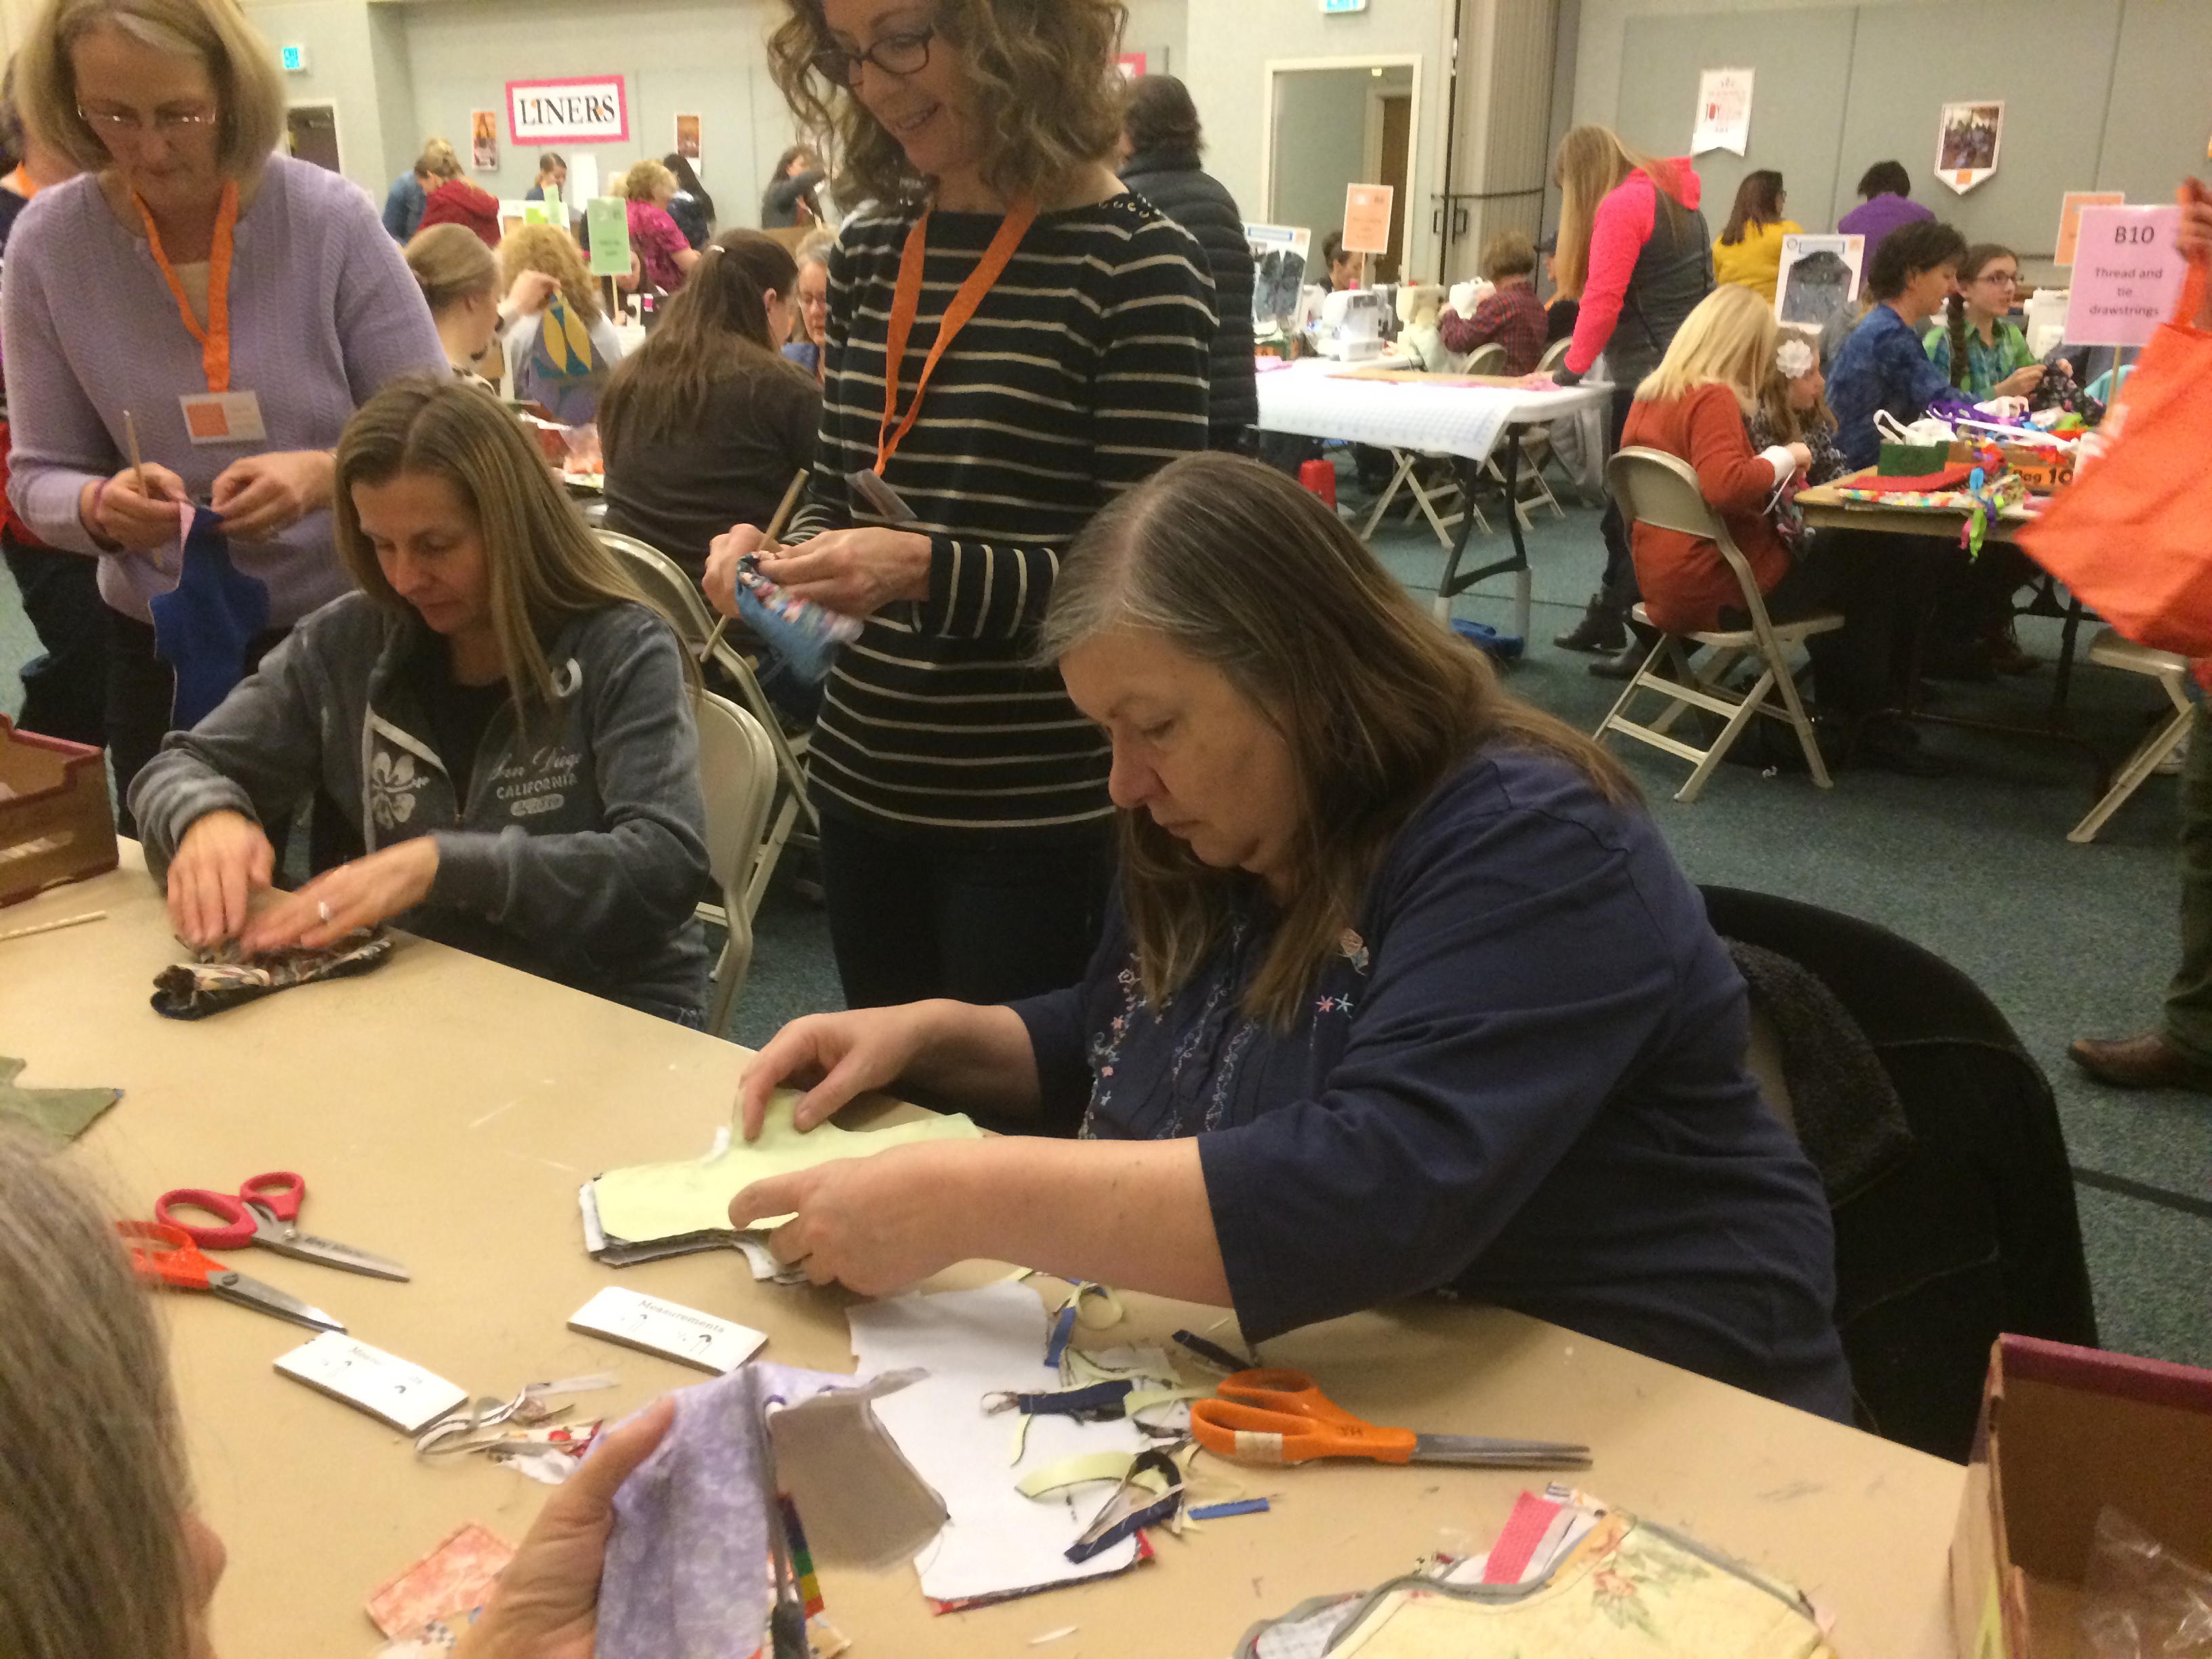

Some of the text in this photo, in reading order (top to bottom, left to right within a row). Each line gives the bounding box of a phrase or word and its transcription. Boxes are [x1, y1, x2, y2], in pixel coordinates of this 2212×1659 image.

[519, 94, 615, 126] LINERS
[2114, 226, 2155, 245] B10
[2095, 267, 2163, 279] Thread and
[2117, 287, 2133, 297] tie
[2089, 305, 2160, 317] drawstrings
[2049, 468, 2074, 485] 10
[497, 773, 577, 800] CALIFORNIA
[638, 1300, 724, 1334] Measurements
